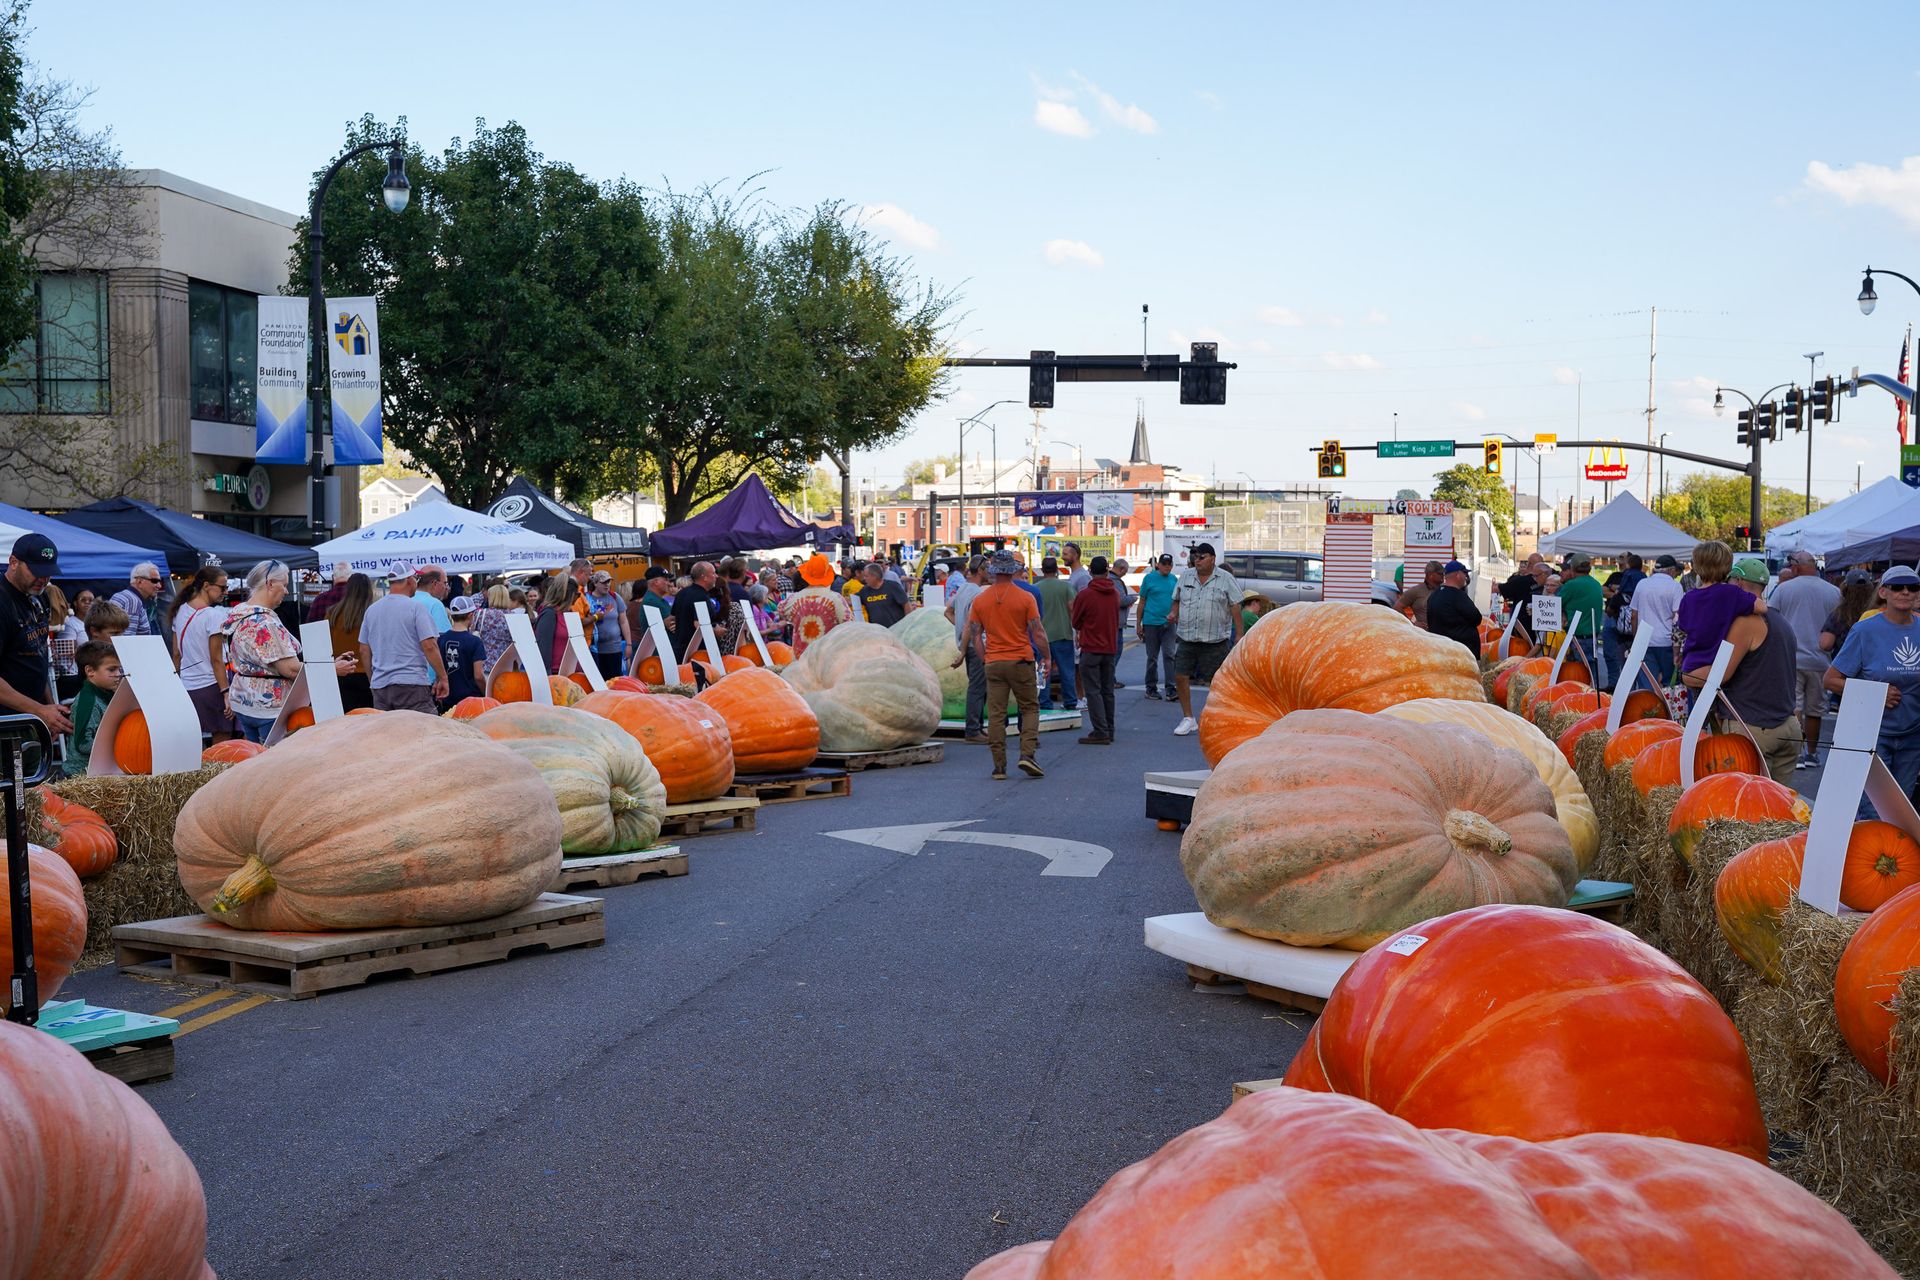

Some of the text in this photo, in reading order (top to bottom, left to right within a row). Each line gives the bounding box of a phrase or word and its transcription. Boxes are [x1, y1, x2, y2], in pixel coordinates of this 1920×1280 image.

[260, 328, 306, 341] Community
[260, 338, 304, 349] Foundation
[259, 366, 297, 379] Building
[331, 369, 366, 380] Growing
[258, 377, 305, 390] Community
[332, 379, 380, 390] Philanthropy
[1412, 446, 1427, 454] King
[1328, 499, 1453, 515] WELCOME GROWERS
[383, 524, 464, 540] PAHHNI
[1415, 532, 1442, 540] TAMZ
[319, 562, 334, 571] est
[416, 555, 427, 564] in
[430, 554, 448, 564] the
[451, 552, 485, 562] World
[510, 551, 519, 560] Best
[520, 551, 534, 561] Tasting
